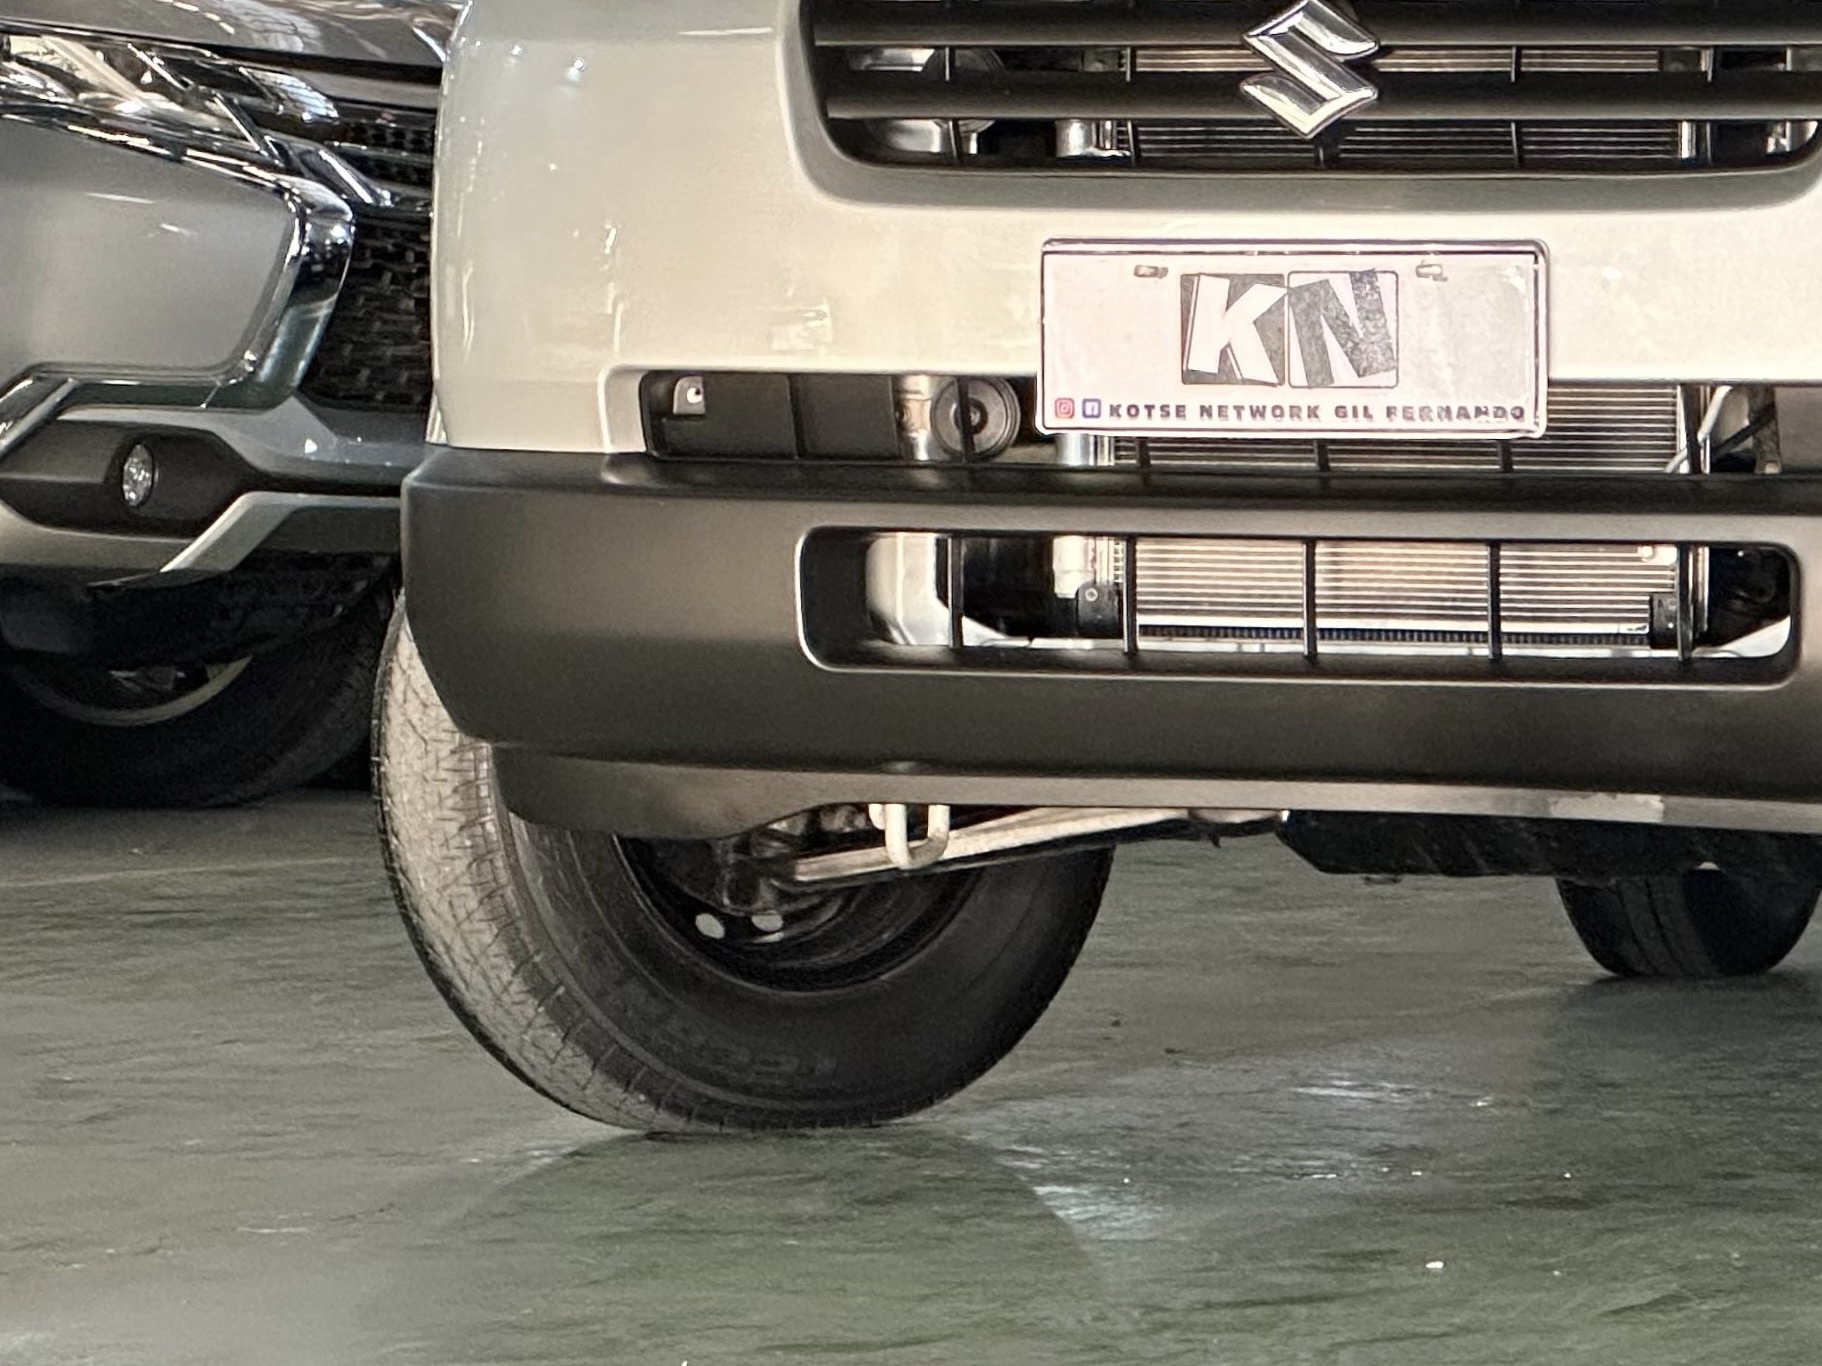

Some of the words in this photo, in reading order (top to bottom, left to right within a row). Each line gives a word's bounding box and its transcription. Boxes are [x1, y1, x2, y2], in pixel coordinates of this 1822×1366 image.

[1108, 403, 1187, 420] KOTSE
[1199, 404, 1321, 422] NETWORK
[1334, 406, 1374, 421] GIL
